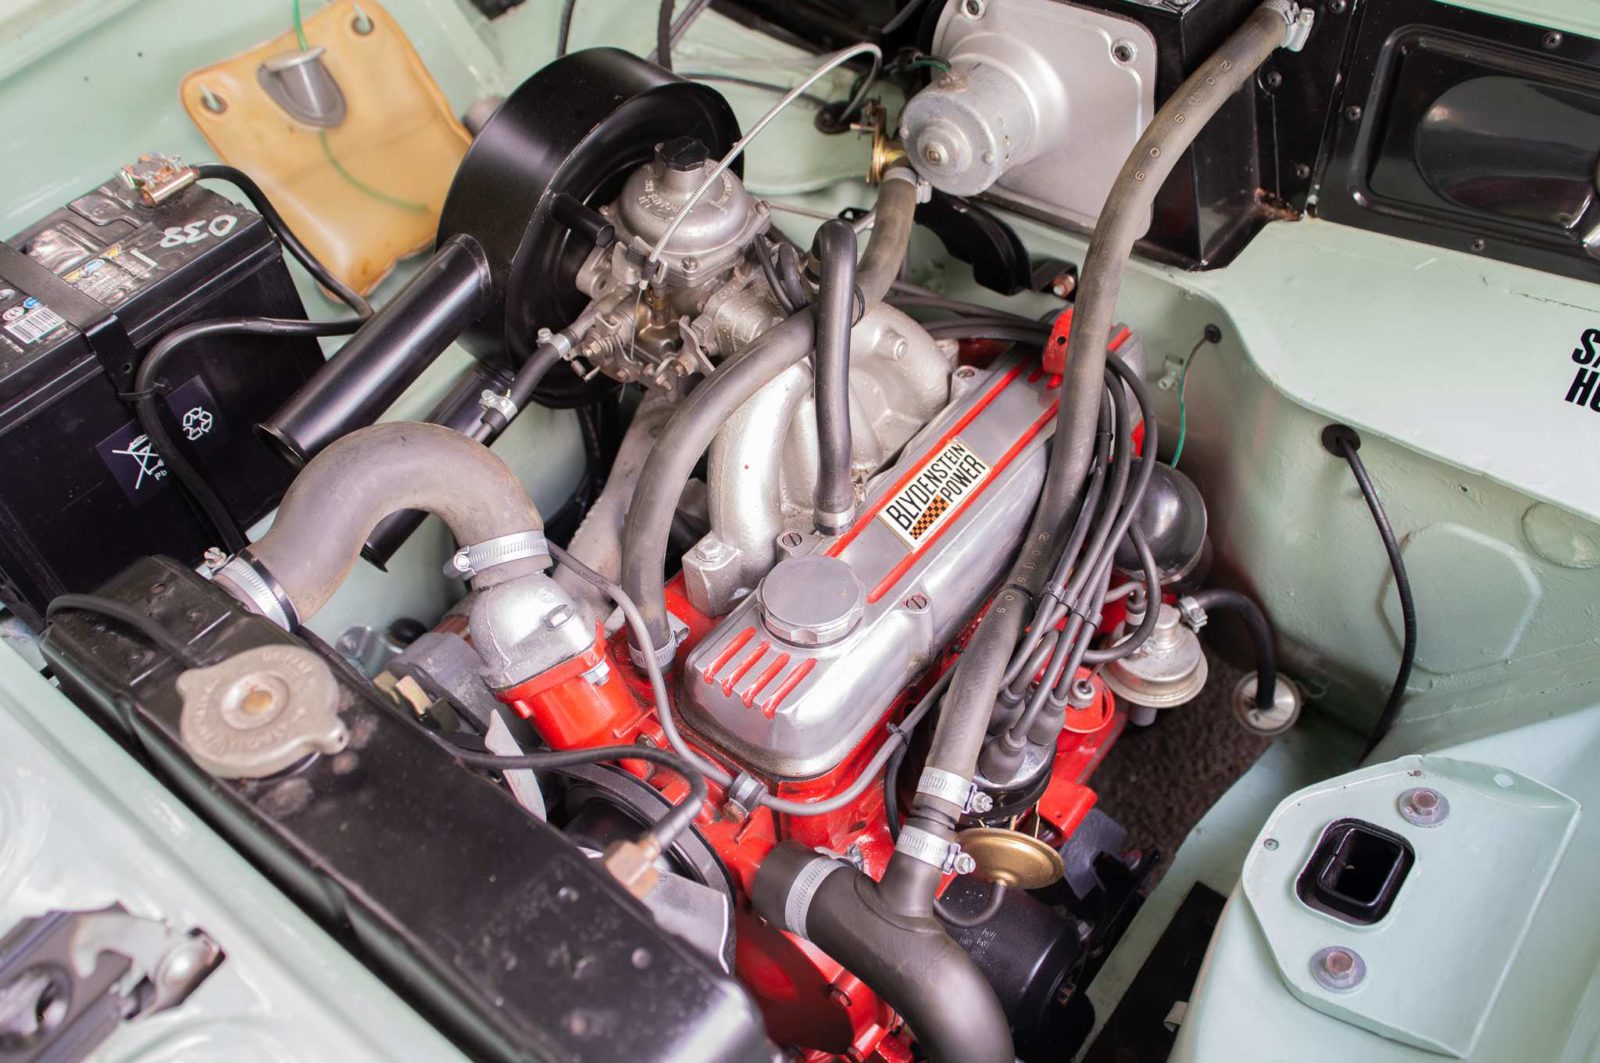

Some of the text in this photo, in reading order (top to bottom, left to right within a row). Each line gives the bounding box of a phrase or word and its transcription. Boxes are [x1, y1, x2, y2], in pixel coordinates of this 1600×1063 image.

[1571, 328, 1600, 368] S
[885, 444, 966, 531] BLYDENSTEIN
[940, 454, 986, 502] POWER
